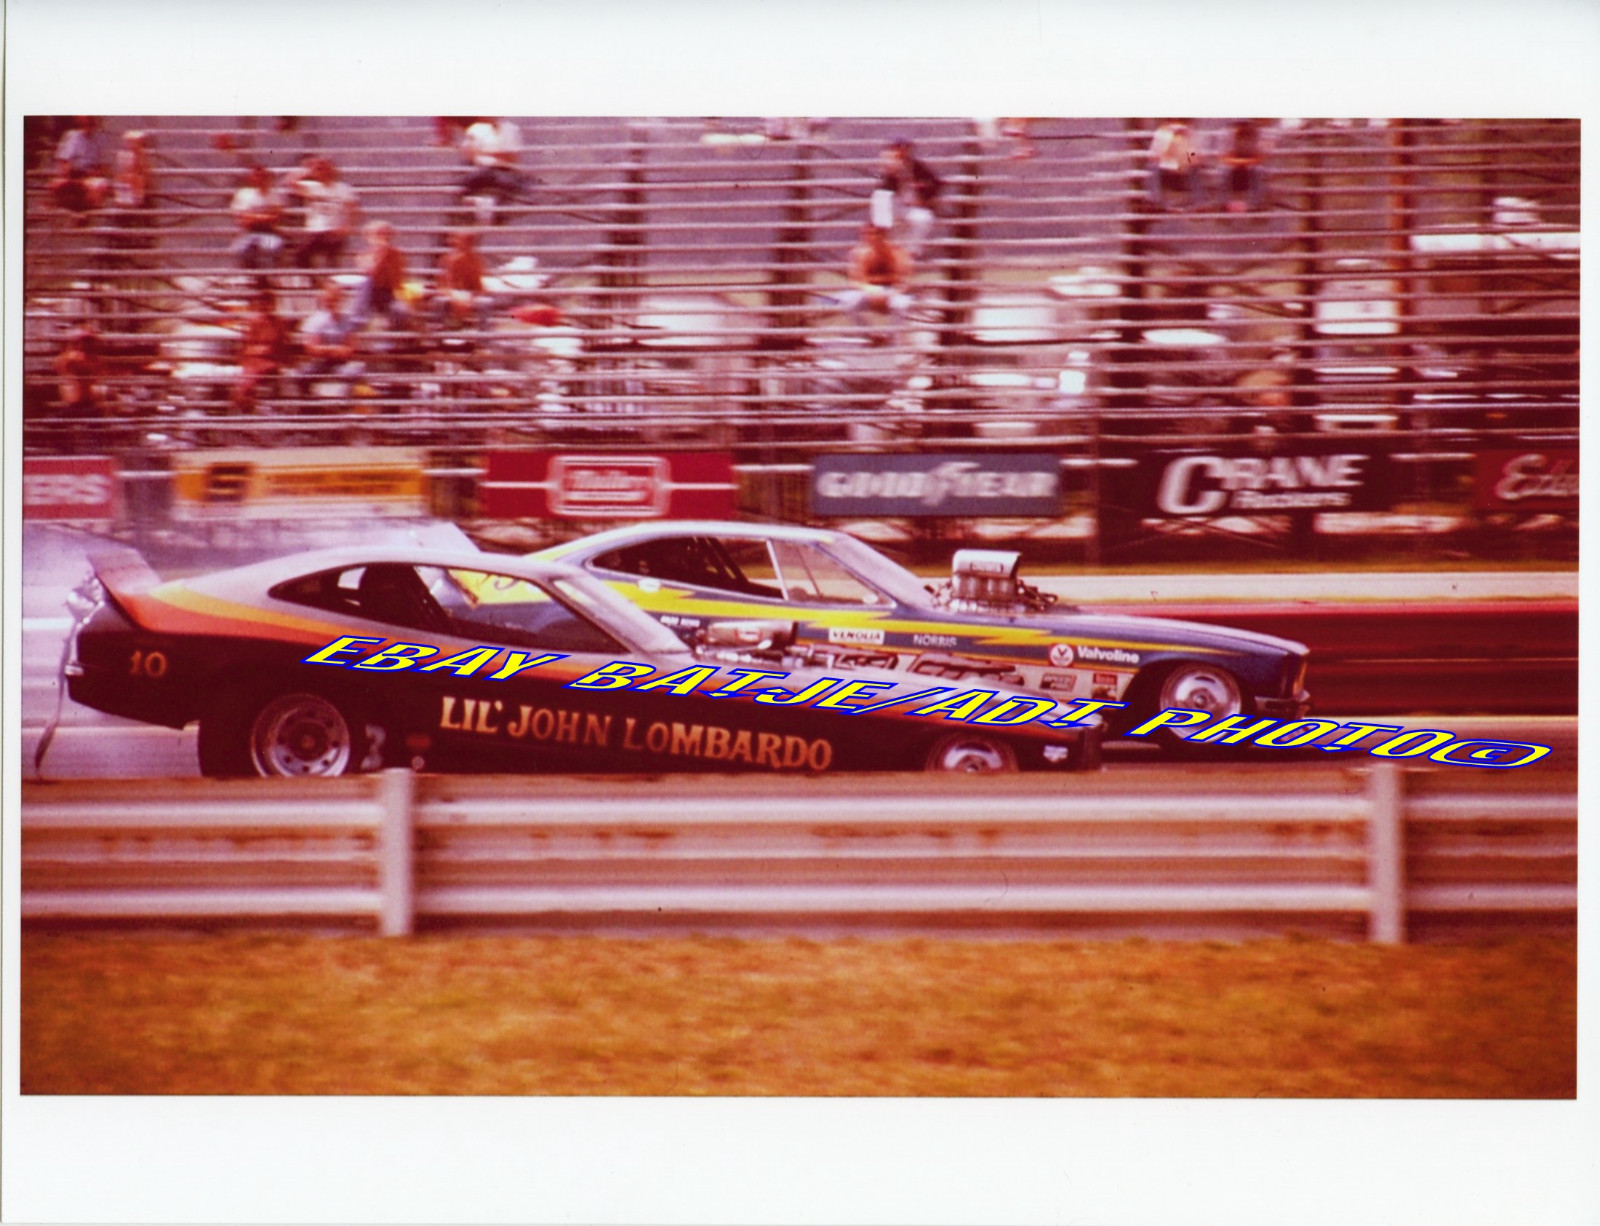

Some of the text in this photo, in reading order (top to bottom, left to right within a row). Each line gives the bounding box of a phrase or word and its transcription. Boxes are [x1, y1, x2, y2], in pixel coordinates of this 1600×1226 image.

[816, 461, 1058, 507] GOODYEAR
[1157, 454, 1369, 514] CRANE
[913, 634, 957, 647] NORRIS
[1077, 645, 1140, 664] Valvoline
[130, 651, 168, 677] 10
[507, 705, 612, 747] JOHN
[622, 717, 833, 771] LOMBARDO
